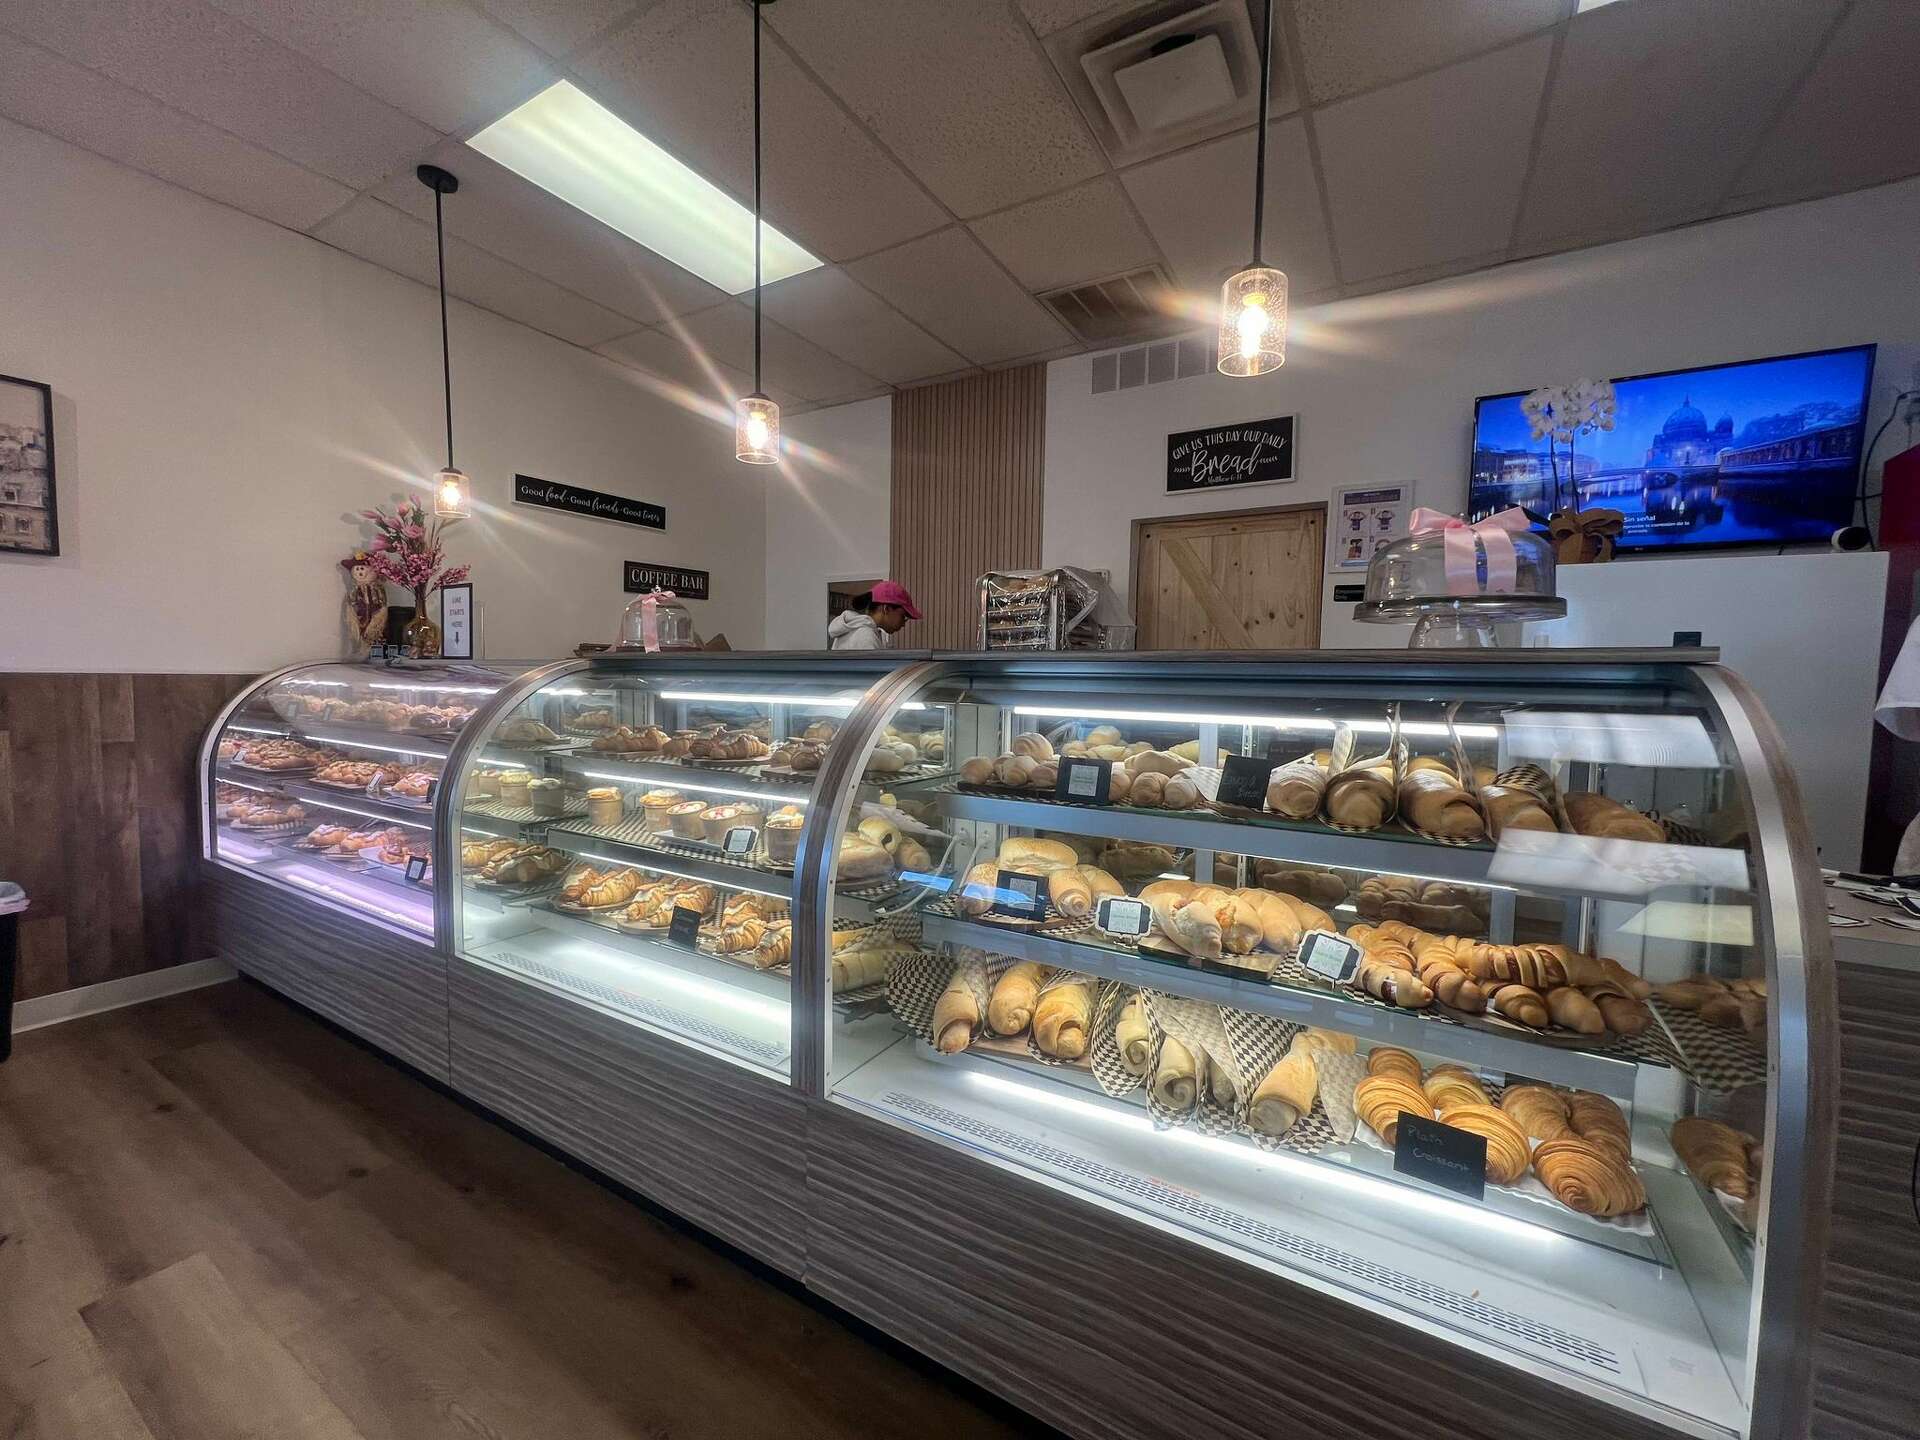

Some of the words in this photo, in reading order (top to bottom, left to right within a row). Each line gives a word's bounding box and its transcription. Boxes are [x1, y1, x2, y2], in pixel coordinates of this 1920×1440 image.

[1172, 443, 1191, 460] GIVE
[1191, 437, 1203, 451] US
[1205, 432, 1224, 446] THIS
[1225, 430, 1241, 442] DAY
[1243, 430, 1261, 443] OUR
[1261, 432, 1287, 449] DAILY
[1191, 443, 1262, 482] Bread
[521, 485, 544, 497] Good
[570, 496, 590, 507] Good
[623, 507, 641, 517] Good
[631, 568, 678, 587] COFFEE
[681, 575, 704, 590] BAR
